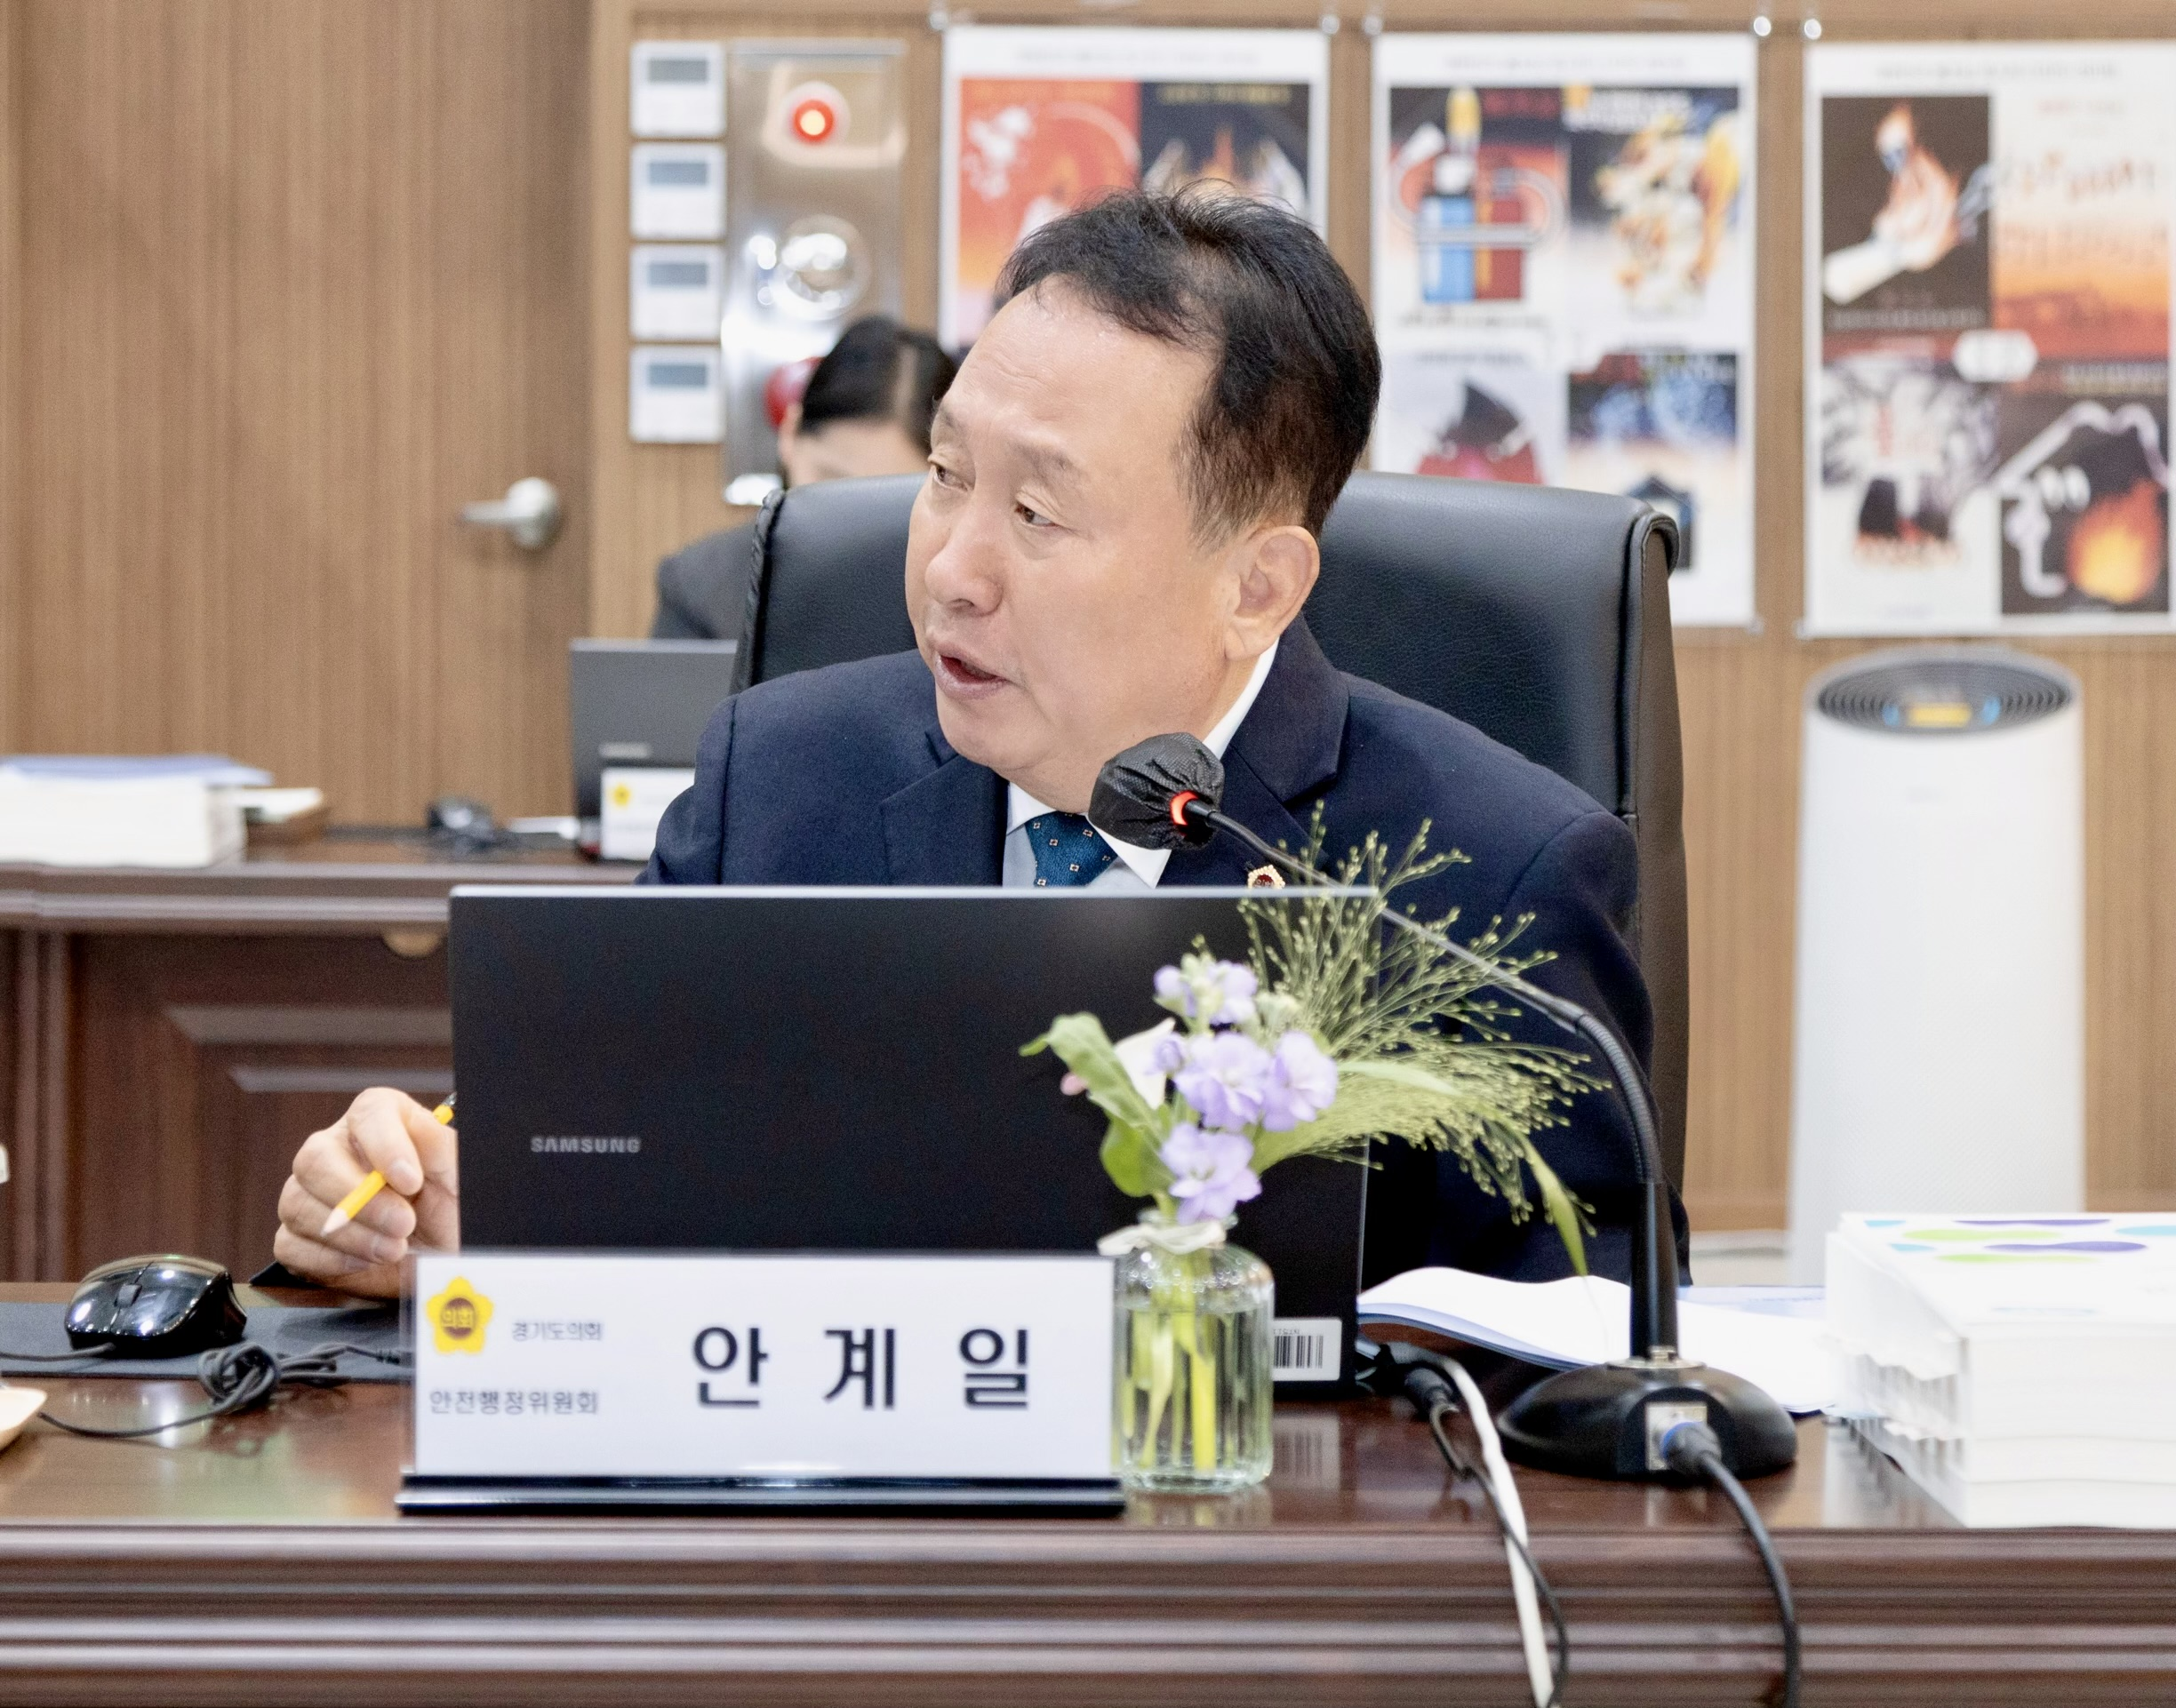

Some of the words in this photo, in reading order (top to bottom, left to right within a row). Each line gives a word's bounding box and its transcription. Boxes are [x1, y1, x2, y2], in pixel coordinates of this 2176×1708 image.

[531, 1136, 641, 1153] SAMSUNG
[511, 1321, 602, 1342] 경기도의회
[429, 1389, 598, 1416] 안전행정위원회
